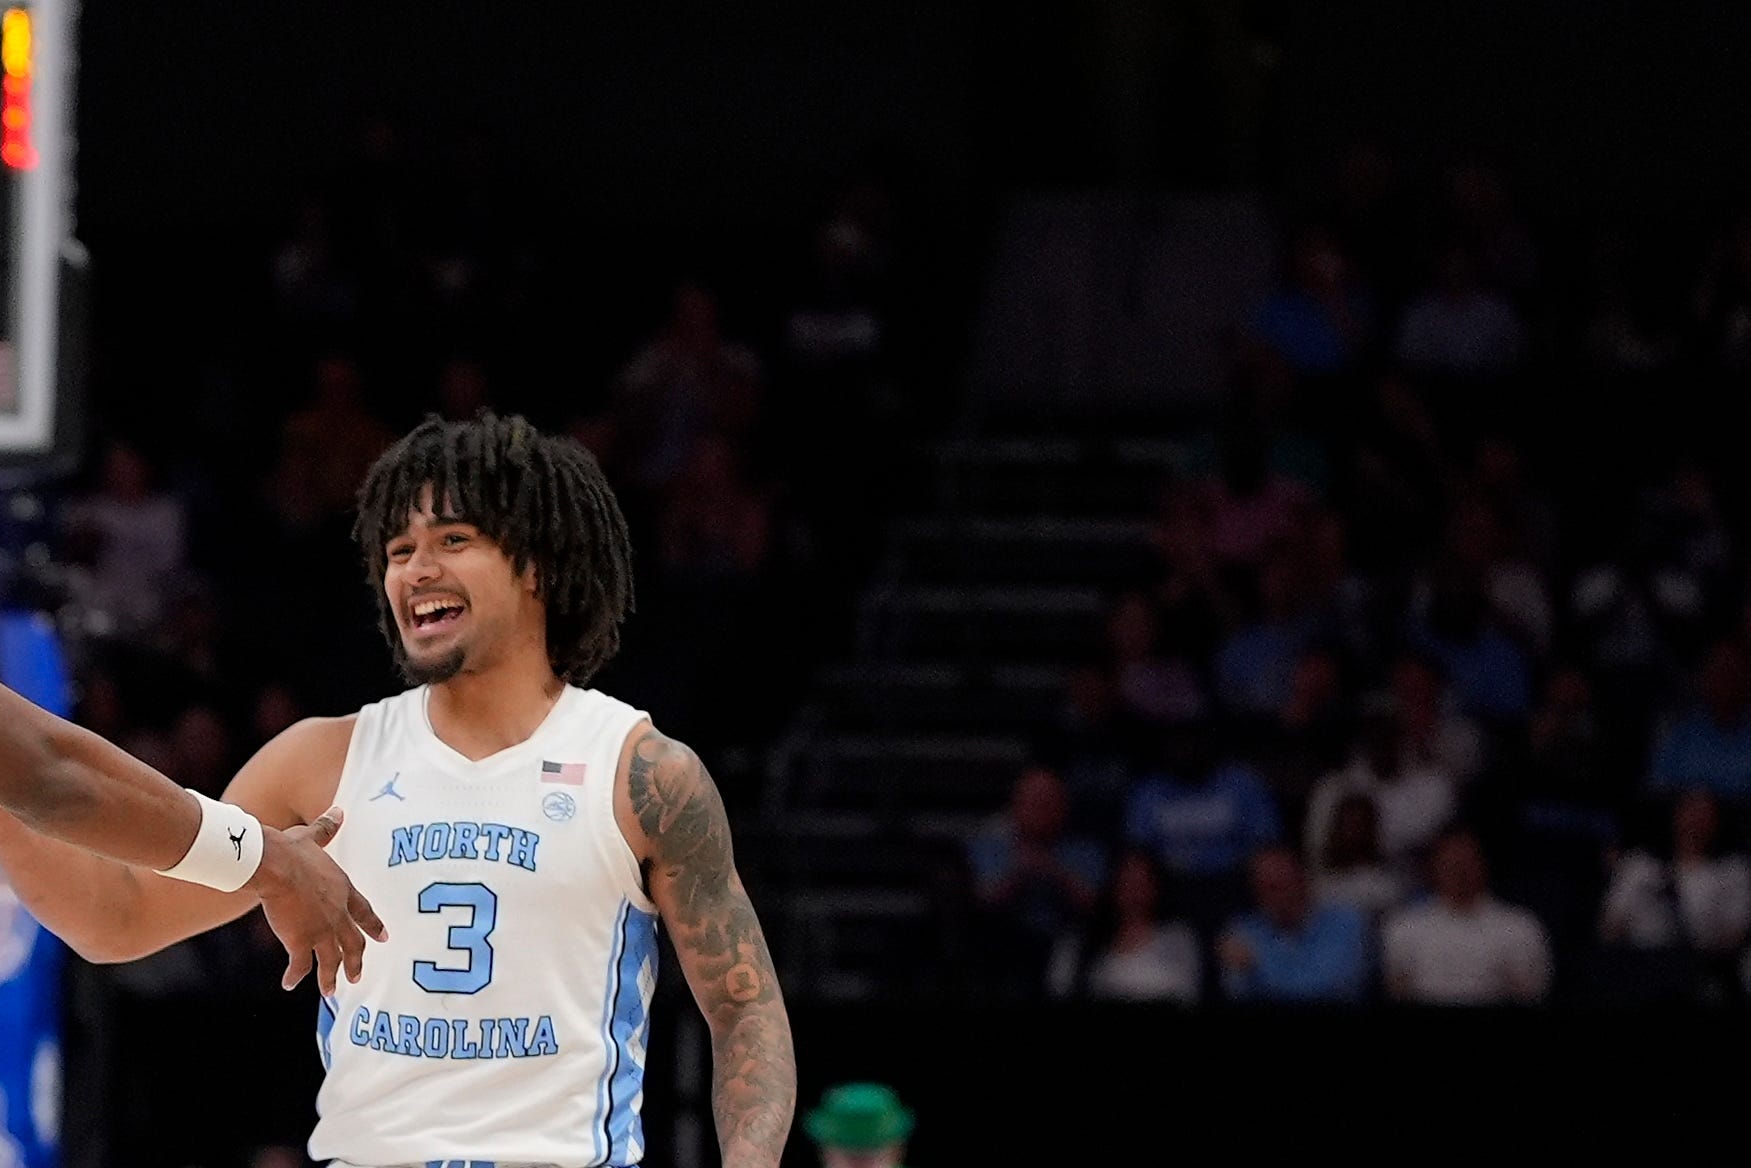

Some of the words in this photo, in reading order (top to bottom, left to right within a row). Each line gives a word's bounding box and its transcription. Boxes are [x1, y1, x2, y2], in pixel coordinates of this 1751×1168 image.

[388, 822, 540, 872] NORTH
[413, 882, 498, 995] 3
[350, 1005, 559, 1060] CAROLINA
